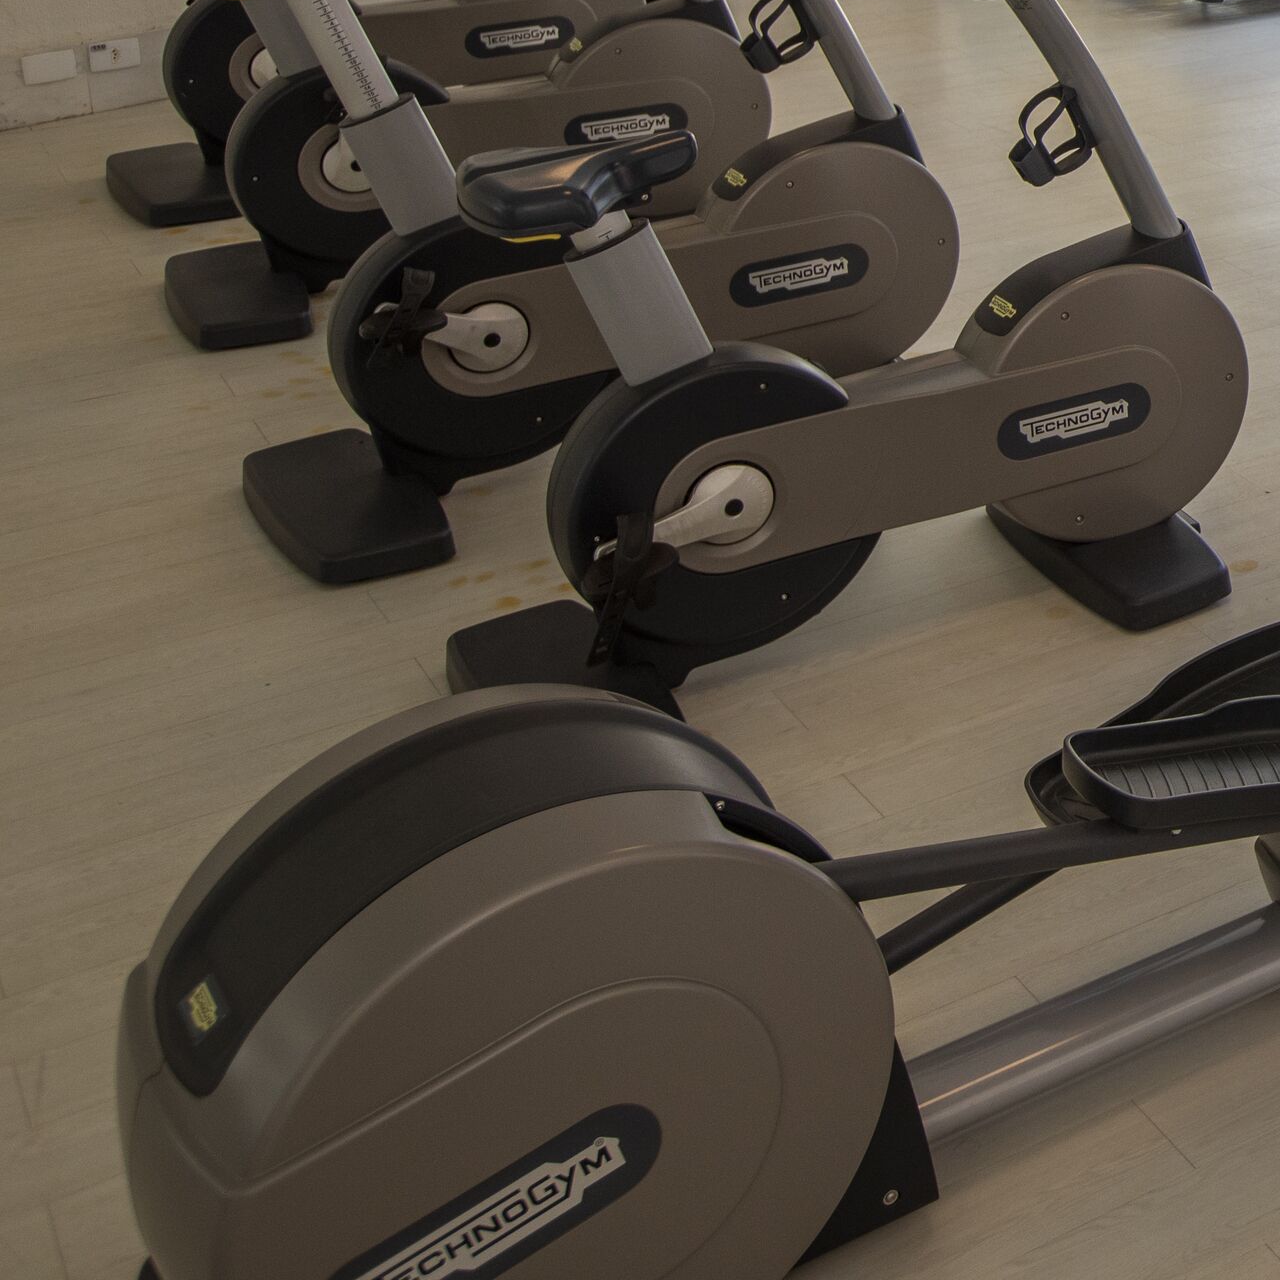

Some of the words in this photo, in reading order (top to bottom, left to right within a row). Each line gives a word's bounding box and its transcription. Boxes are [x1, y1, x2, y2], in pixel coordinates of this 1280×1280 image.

[482, 28, 556, 46] TECHNOGYM
[583, 118, 666, 138] TECHNOGYM
[752, 262, 844, 288] TECHNOGYM
[1022, 402, 1126, 438] TECHNOGYM
